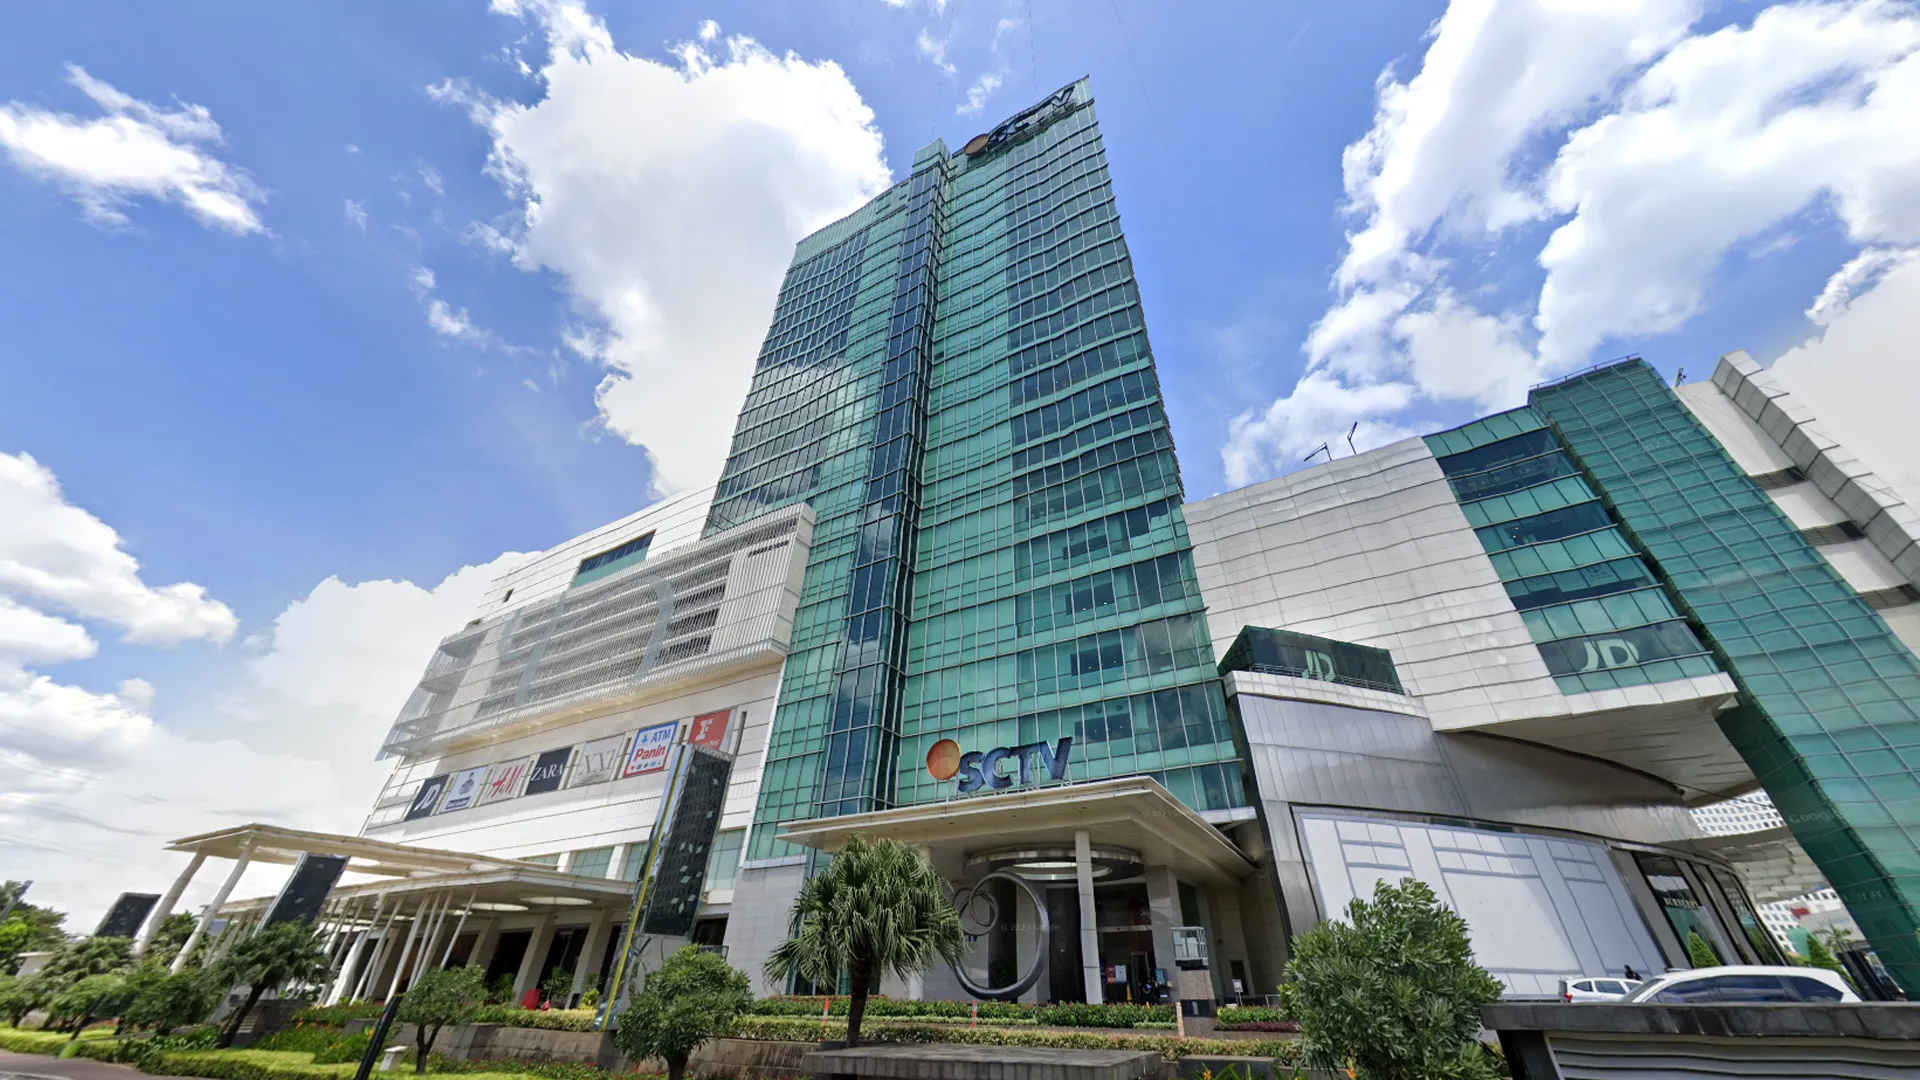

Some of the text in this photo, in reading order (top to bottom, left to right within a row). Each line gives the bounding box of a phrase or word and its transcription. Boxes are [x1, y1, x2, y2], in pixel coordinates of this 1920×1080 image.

[1302, 650, 1336, 682] JD
[1580, 638, 1639, 672] JD
[651, 728, 672, 743] ATM
[577, 748, 618, 776] XXI
[634, 745, 666, 762] Panin
[957, 736, 1073, 793] SCTV
[530, 763, 564, 781] ZARA
[413, 783, 441, 811] JD
